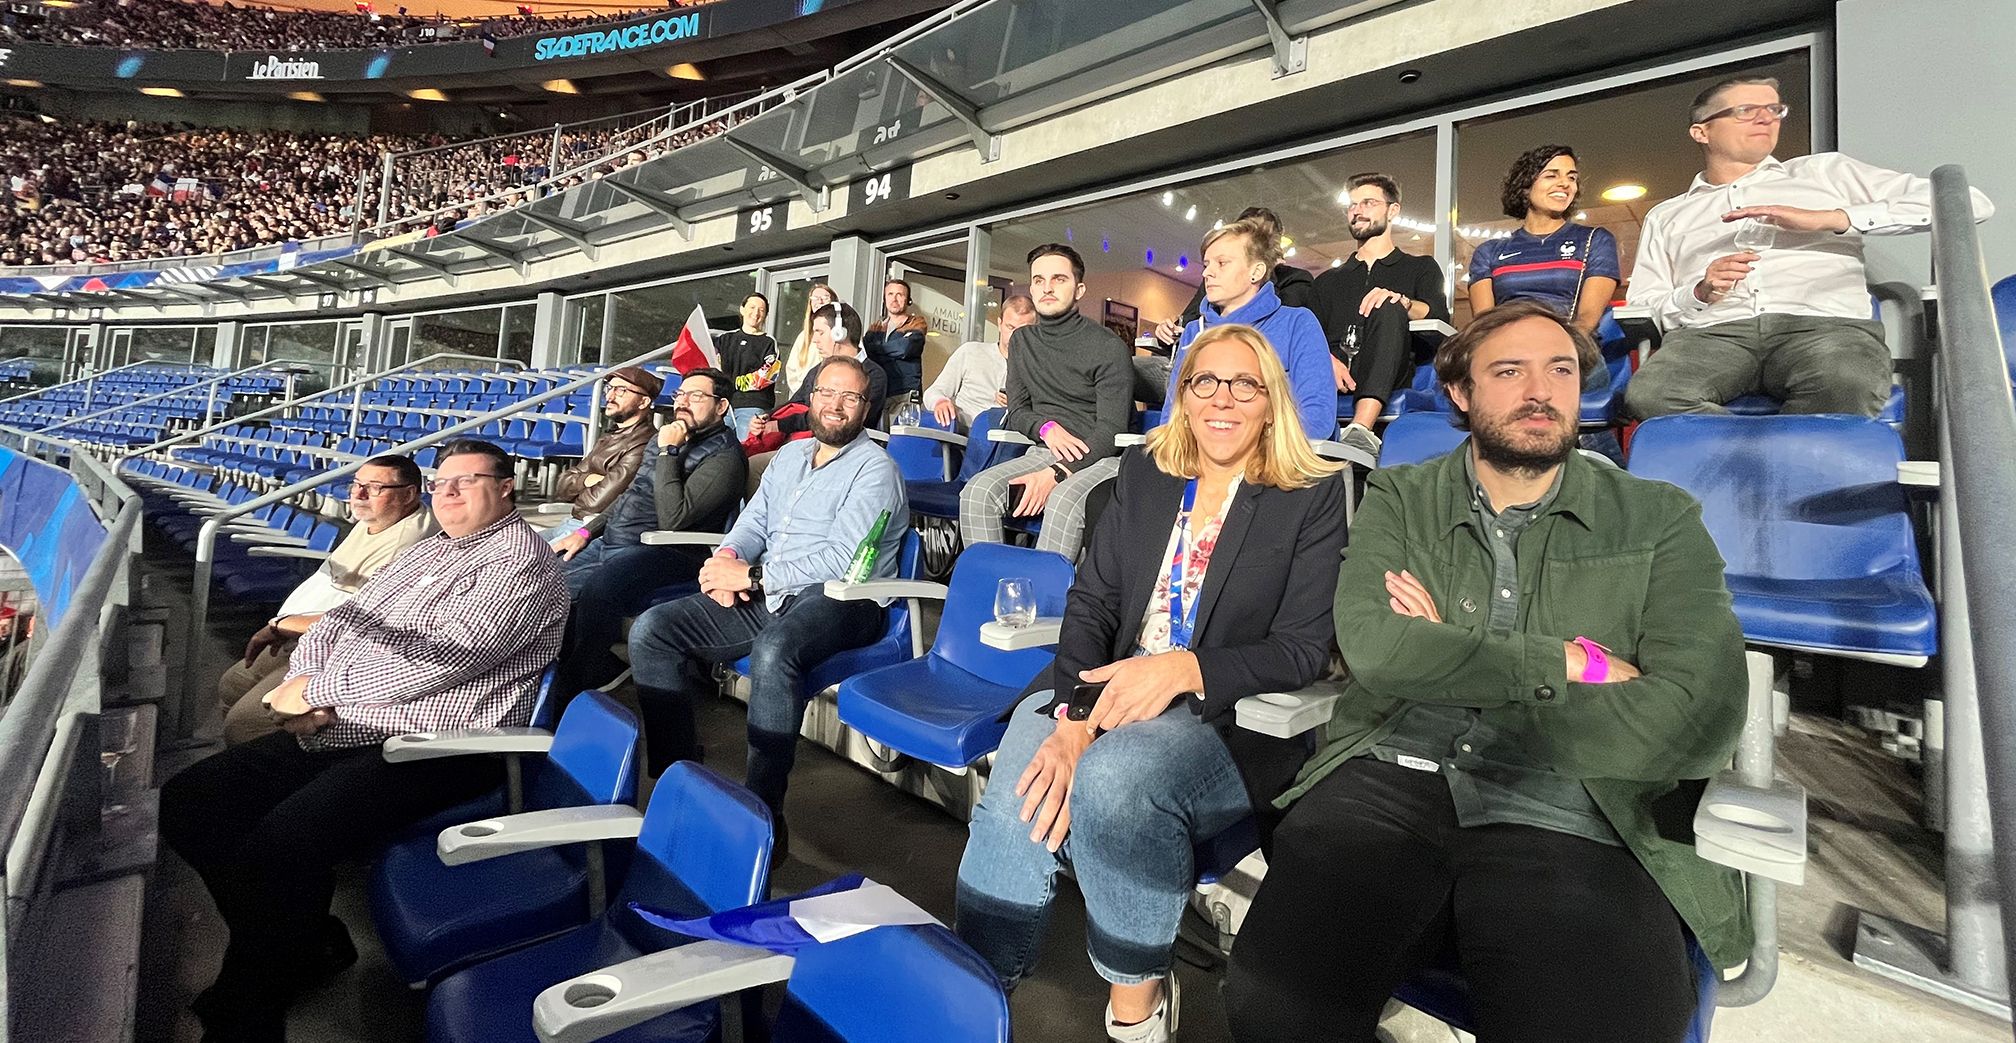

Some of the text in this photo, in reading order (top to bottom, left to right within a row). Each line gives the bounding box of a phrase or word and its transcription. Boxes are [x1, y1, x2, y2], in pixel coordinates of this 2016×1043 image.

[534, 13, 700, 61] STADEFRANCE.COM
[267, 55, 319, 78] Parisien
[865, 173, 892, 206] 94
[750, 207, 773, 234] 95
[932, 306, 962, 321] AMAU
